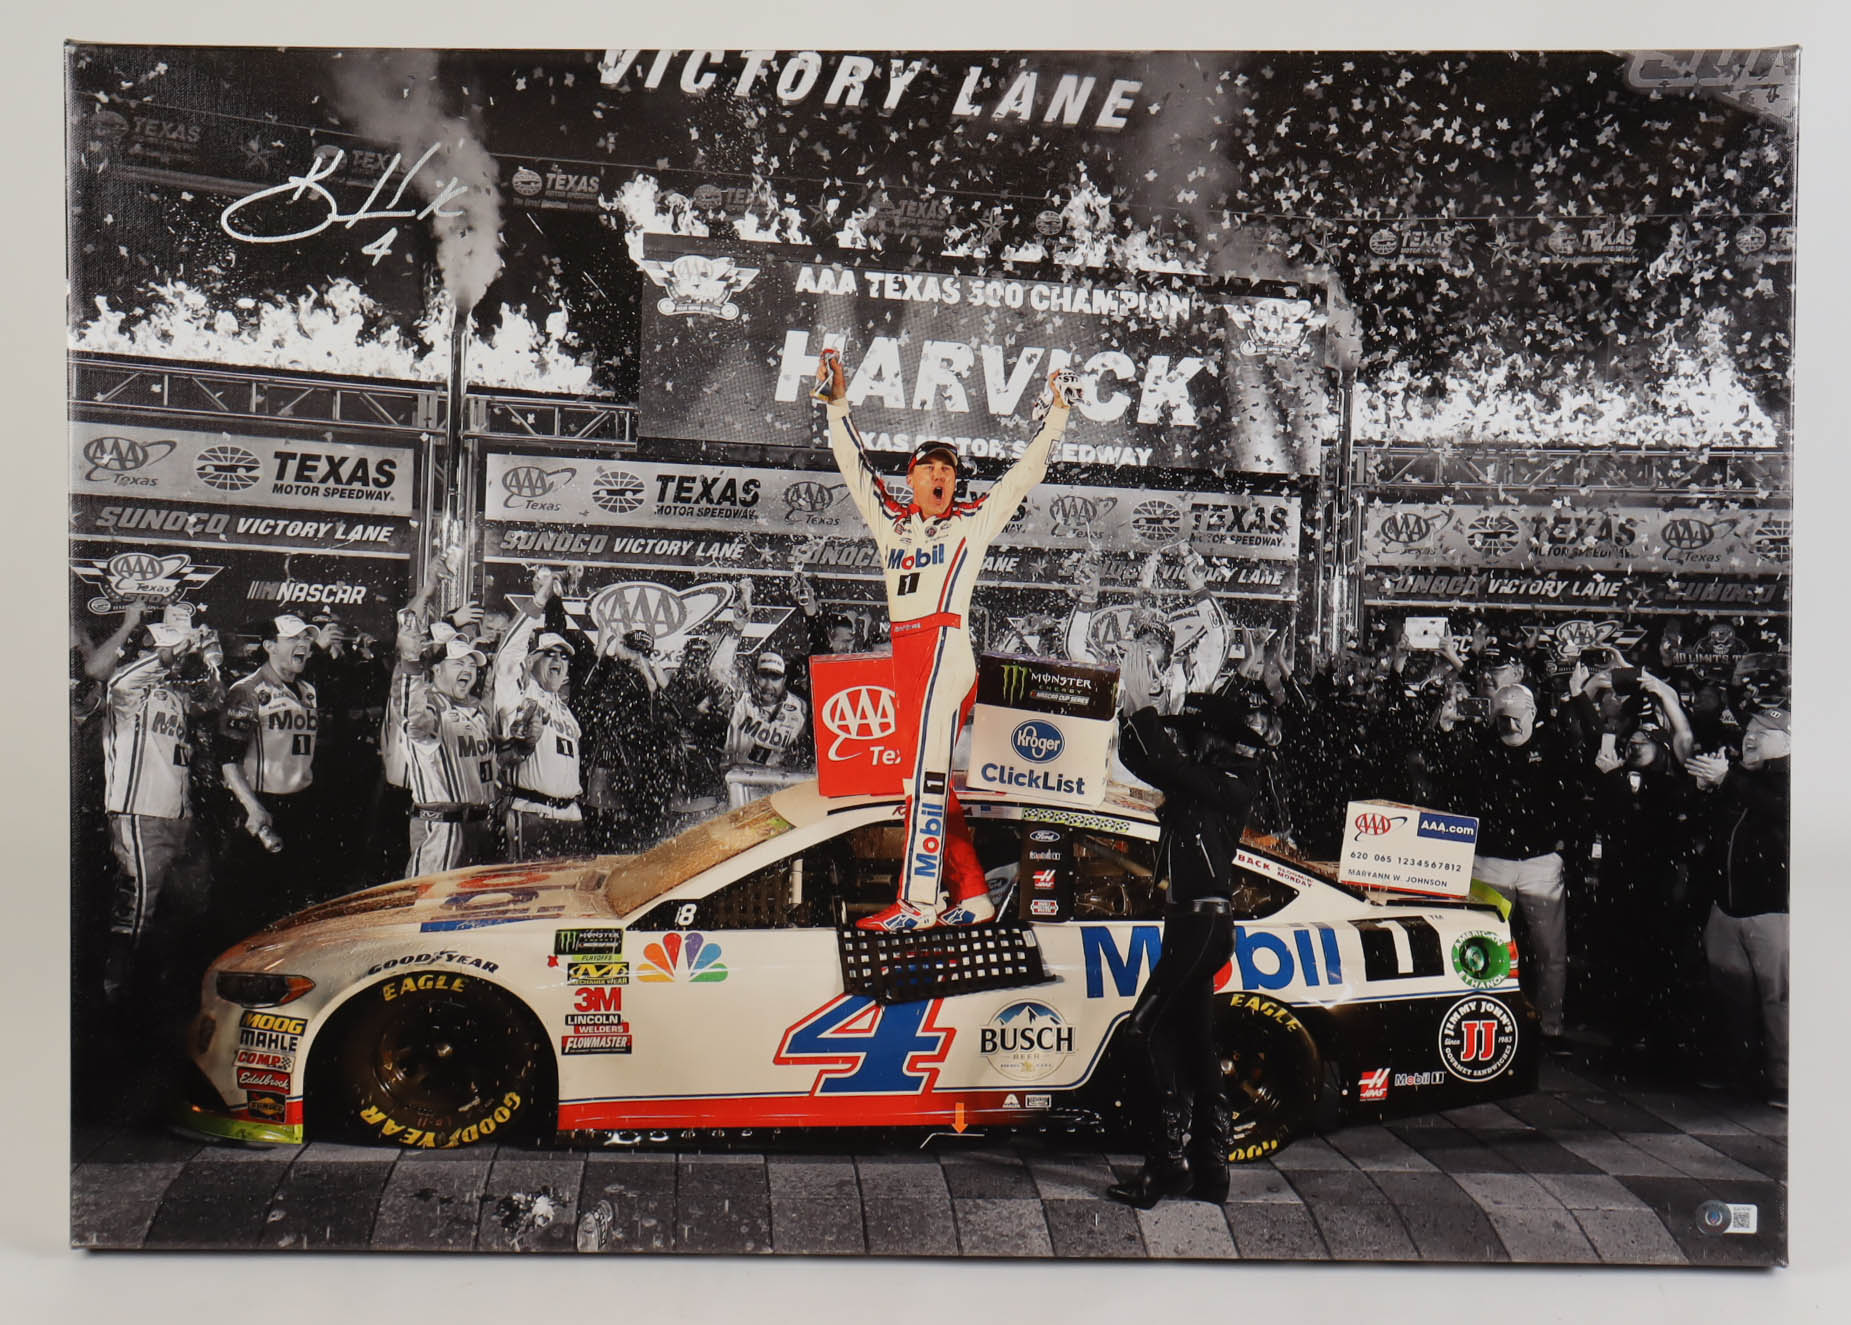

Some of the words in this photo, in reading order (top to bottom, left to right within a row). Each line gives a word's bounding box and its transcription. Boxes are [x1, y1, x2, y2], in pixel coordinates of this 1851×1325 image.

[599, 50, 923, 110] VICTORY
[952, 65, 1144, 130] LANE
[134, 116, 200, 143] TEXAS
[546, 172, 600, 193] TEXAS
[1401, 231, 1454, 248] TEXAS
[795, 267, 857, 296] AAA
[864, 272, 961, 304] TEXAS
[1030, 285, 1193, 321] CHAMPION
[85, 437, 146, 471] AAA
[111, 473, 159, 487] Texas
[272, 451, 397, 489] TEXAS
[503, 467, 552, 497] AAA
[272, 483, 320, 498] MOTOR
[323, 486, 392, 501] SPEEDWAY
[656, 474, 761, 507] TEXAS
[526, 500, 561, 512] Texas
[655, 505, 696, 517] MOTOR
[698, 507, 757, 520] SPEEDWAY
[96, 506, 231, 534] SUNOCO
[236, 517, 333, 540] VICTORY
[334, 521, 395, 542] LANE
[805, 515, 840, 526] Texas
[1190, 503, 1289, 535] TEXAS
[1382, 514, 1430, 542] AAA
[500, 530, 608, 554] SUNOCO
[613, 536, 692, 557] VICTORY
[695, 543, 745, 560] LANE
[1666, 519, 1711, 549] AAA
[118, 555, 162, 580] AAA
[888, 544, 944, 570] Mobil
[984, 556, 1020, 572] ANE
[1684, 551, 1721, 562] Texas
[136, 583, 171, 593] Texas
[1238, 568, 1285, 586] LANE
[1487, 578, 1569, 598] VICTORY
[1571, 580, 1622, 598] LANE
[277, 582, 367, 606] NASCAR
[606, 588, 682, 638] AAA
[1031, 672, 1092, 689] MONSTER
[832, 687, 896, 739] AAA
[739, 716, 791, 748] Mobil
[1017, 726, 1061, 758] Kroger
[981, 763, 1085, 796] ClickList
[1356, 813, 1391, 836] AAA
[1421, 820, 1474, 836] AAA.com
[914, 802, 944, 878] Mobil
[1237, 854, 1271, 870] BACK
[1350, 851, 1368, 860] 620
[1374, 854, 1392, 863] 065
[1398, 857, 1462, 872] 1234567812
[1277, 871, 1313, 888] MONDAY
[1348, 868, 1390, 880] MARYANN
[1406, 876, 1448, 887] JOHNSON
[382, 975, 466, 1001] EAGLE
[1459, 972, 1506, 989] ETHANOL
[574, 987, 622, 1013] 3M
[246, 1013, 305, 1034] MOOG
[567, 1015, 618, 1025] LINCOLN
[1230, 993, 1302, 1032] EAGLE
[1444, 1001, 1477, 1036] JIMMY
[1480, 1001, 1513, 1034] JOHN'S
[240, 1029, 298, 1052] MAHLE
[578, 1025, 624, 1033] WELDERS
[980, 1026, 1074, 1054] BUSCH
[1461, 1020, 1498, 1061] JJ
[565, 1036, 628, 1053] FLOWMASTER
[773, 992, 957, 1097] 4
[1445, 1047, 1472, 1076] GOURMET
[1473, 1044, 1512, 1077] SANDWICHES
[240, 1072, 289, 1089] Edelbrock
[1394, 1072, 1430, 1087] Mobil
